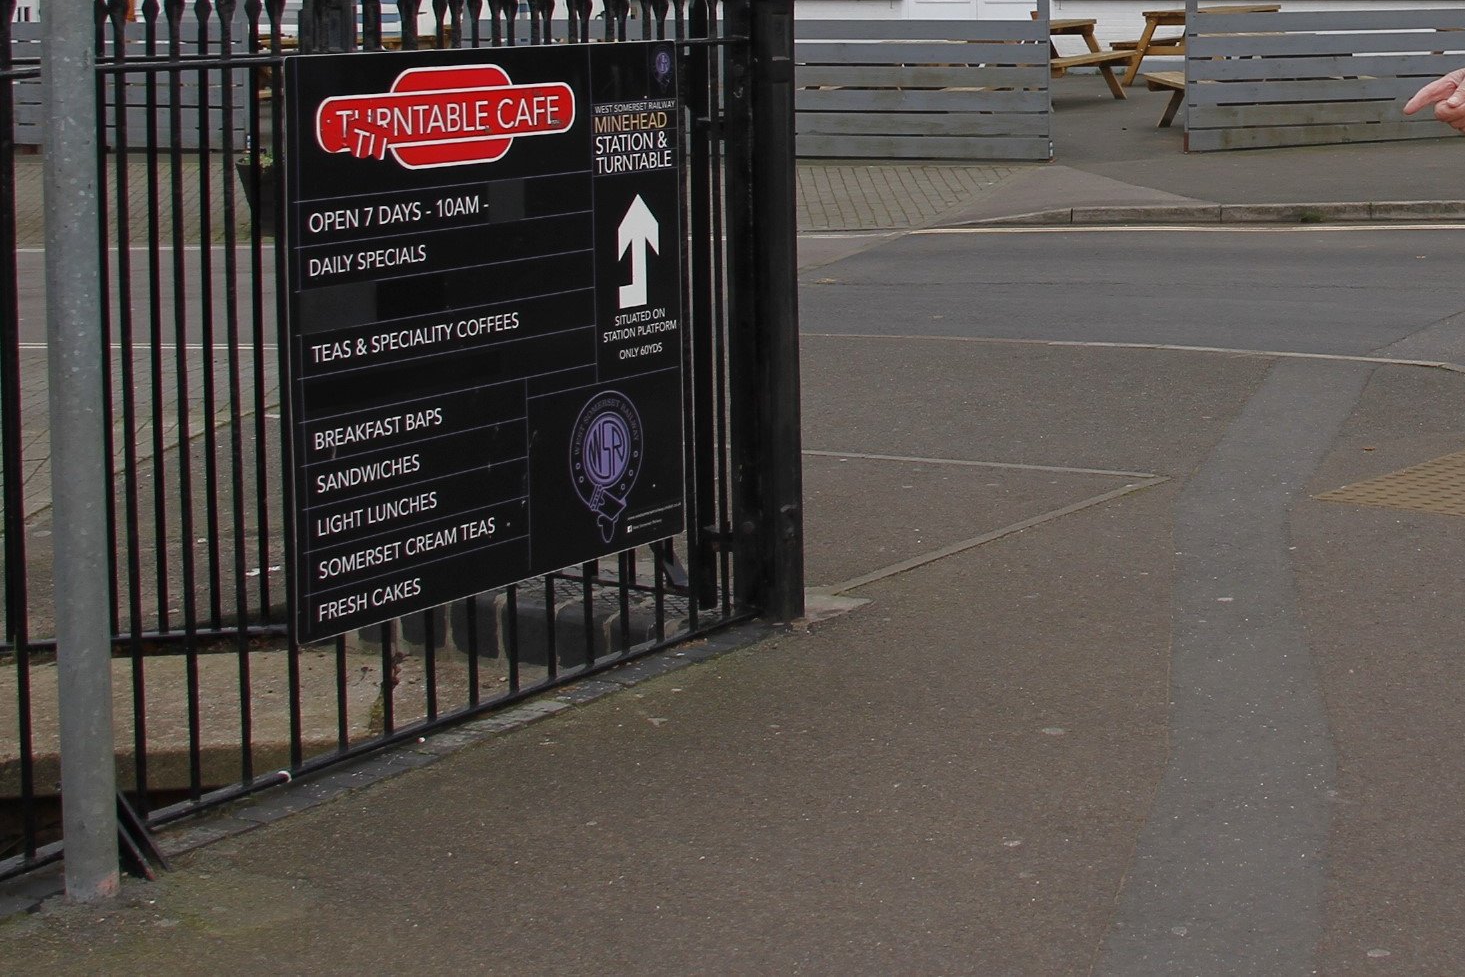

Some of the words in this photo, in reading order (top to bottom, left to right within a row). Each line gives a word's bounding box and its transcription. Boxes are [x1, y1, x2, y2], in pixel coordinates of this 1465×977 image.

[497, 95, 560, 129] CAFE
[594, 104, 613, 114] WEST
[613, 101, 648, 113] SOMERSET
[648, 100, 676, 110] RAILWAY
[594, 111, 668, 134] MINEHEAD
[595, 132, 653, 155] STATION
[657, 130, 668, 149] &
[595, 150, 672, 174] TURNTABLE
[308, 208, 359, 233] OPEN
[363, 206, 374, 227] 7
[378, 201, 422, 225] DAYS
[436, 195, 480, 218] 10AM
[308, 253, 354, 277] DAILY
[357, 243, 427, 271] SPECIALS
[603, 326, 636, 343] STATION
[637, 319, 677, 336] PLATFORM
[614, 310, 651, 327] SITUATED
[652, 307, 666, 320] ON
[312, 339, 352, 363] TEAS
[355, 337, 368, 356] &
[371, 322, 454, 354] SPECIALITY
[457, 311, 520, 339] COFFEES
[619, 346, 640, 360] ONLY
[640, 341, 663, 356] 60YDS
[314, 415, 402, 451] BREAKFAST
[405, 407, 443, 432] BAPS
[316, 453, 420, 494] SANDWICHES
[317, 508, 364, 537] LIGHT
[367, 491, 438, 525] LUNCHES
[319, 541, 402, 580] SOMERSET
[405, 526, 458, 556] CREAM
[460, 516, 496, 541] TEAS
[318, 591, 368, 623] FRESH
[372, 577, 422, 606] CAKES
